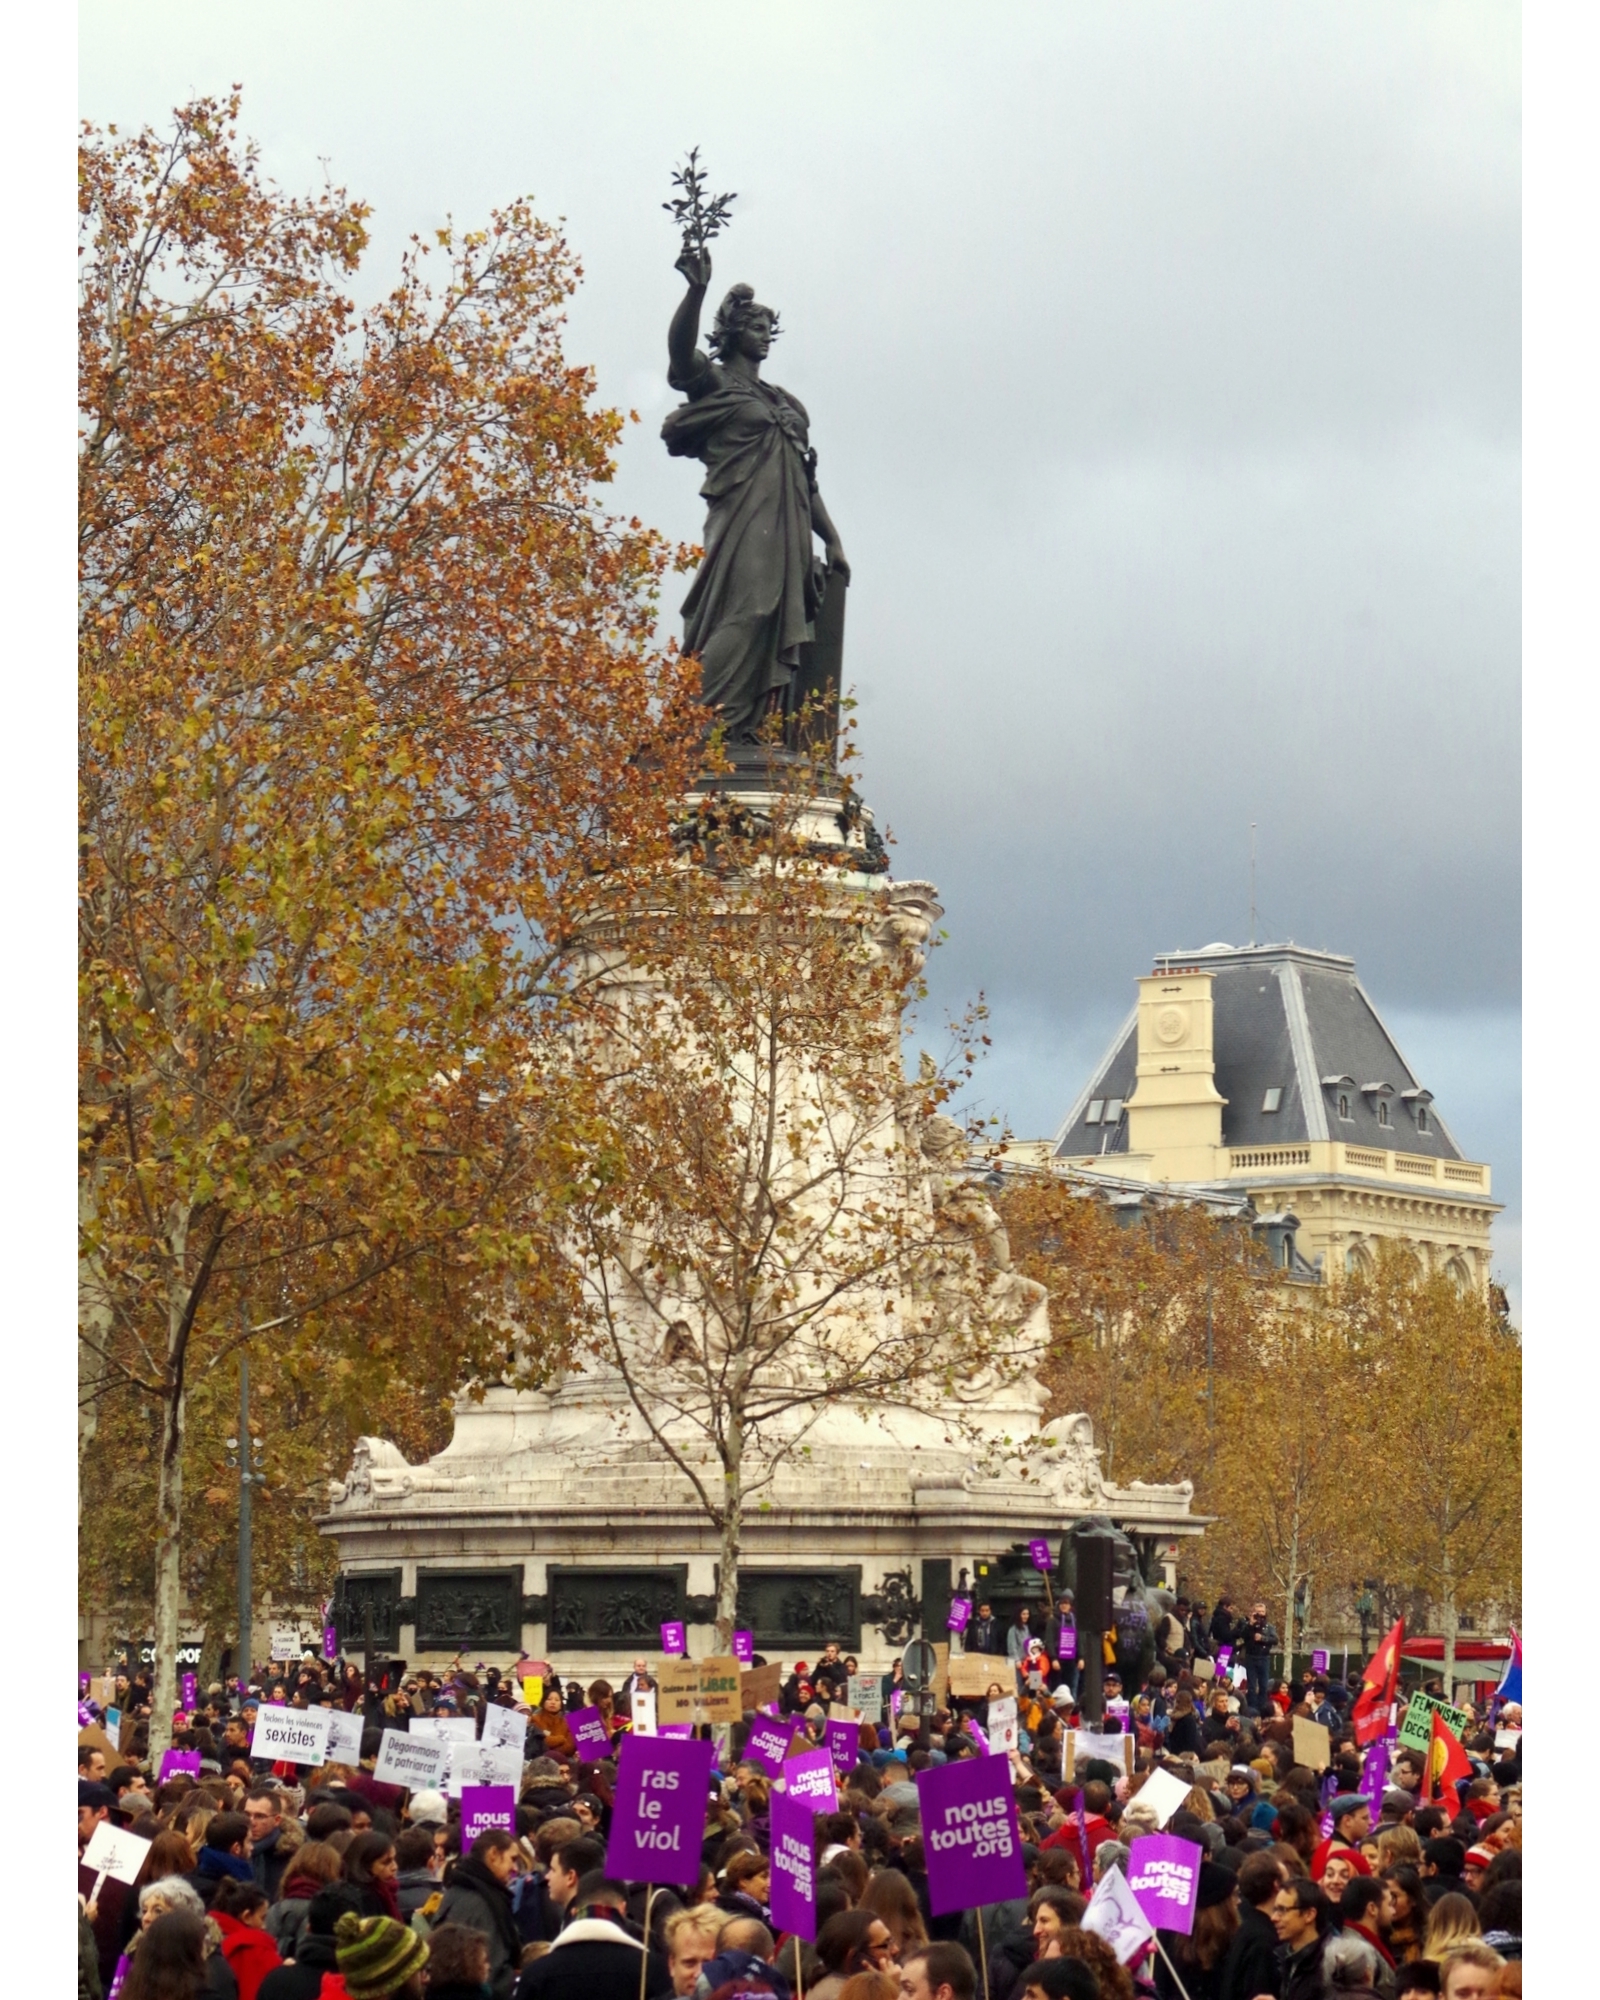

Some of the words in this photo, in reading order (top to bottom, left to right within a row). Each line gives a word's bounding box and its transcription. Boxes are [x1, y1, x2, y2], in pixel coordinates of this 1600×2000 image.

[285, 1716, 294, 1726] les
[296, 1718, 322, 1730] violences
[579, 1720, 601, 1732] nous
[265, 1728, 316, 1747] sexistes
[575, 1728, 603, 1742] toutes
[761, 1731, 788, 1747] nous
[832, 1731, 847, 1740] ras
[388, 1737, 441, 1759] Dégommons
[752, 1735, 785, 1755] toutes
[832, 1740, 841, 1750] le
[384, 1752, 393, 1765] le
[394, 1757, 437, 1774] patriarcat
[832, 1751, 849, 1761] viol
[641, 1769, 680, 1790] ras
[797, 1767, 829, 1783] nous
[790, 1777, 831, 1796] toutes
[638, 1792, 662, 1819] le
[945, 1796, 1008, 1825] nous
[473, 1813, 510, 1825] nous
[634, 1824, 680, 1851] viol
[930, 1818, 1011, 1851] toutes
[782, 1834, 811, 1862] nous
[972, 1836, 1013, 1858] .org
[774, 1847, 812, 1883] toutes
[1144, 1861, 1193, 1880] nous
[793, 1878, 812, 1902] .org
[1130, 1873, 1191, 1893] toutes
[1156, 1887, 1190, 1906] .org
